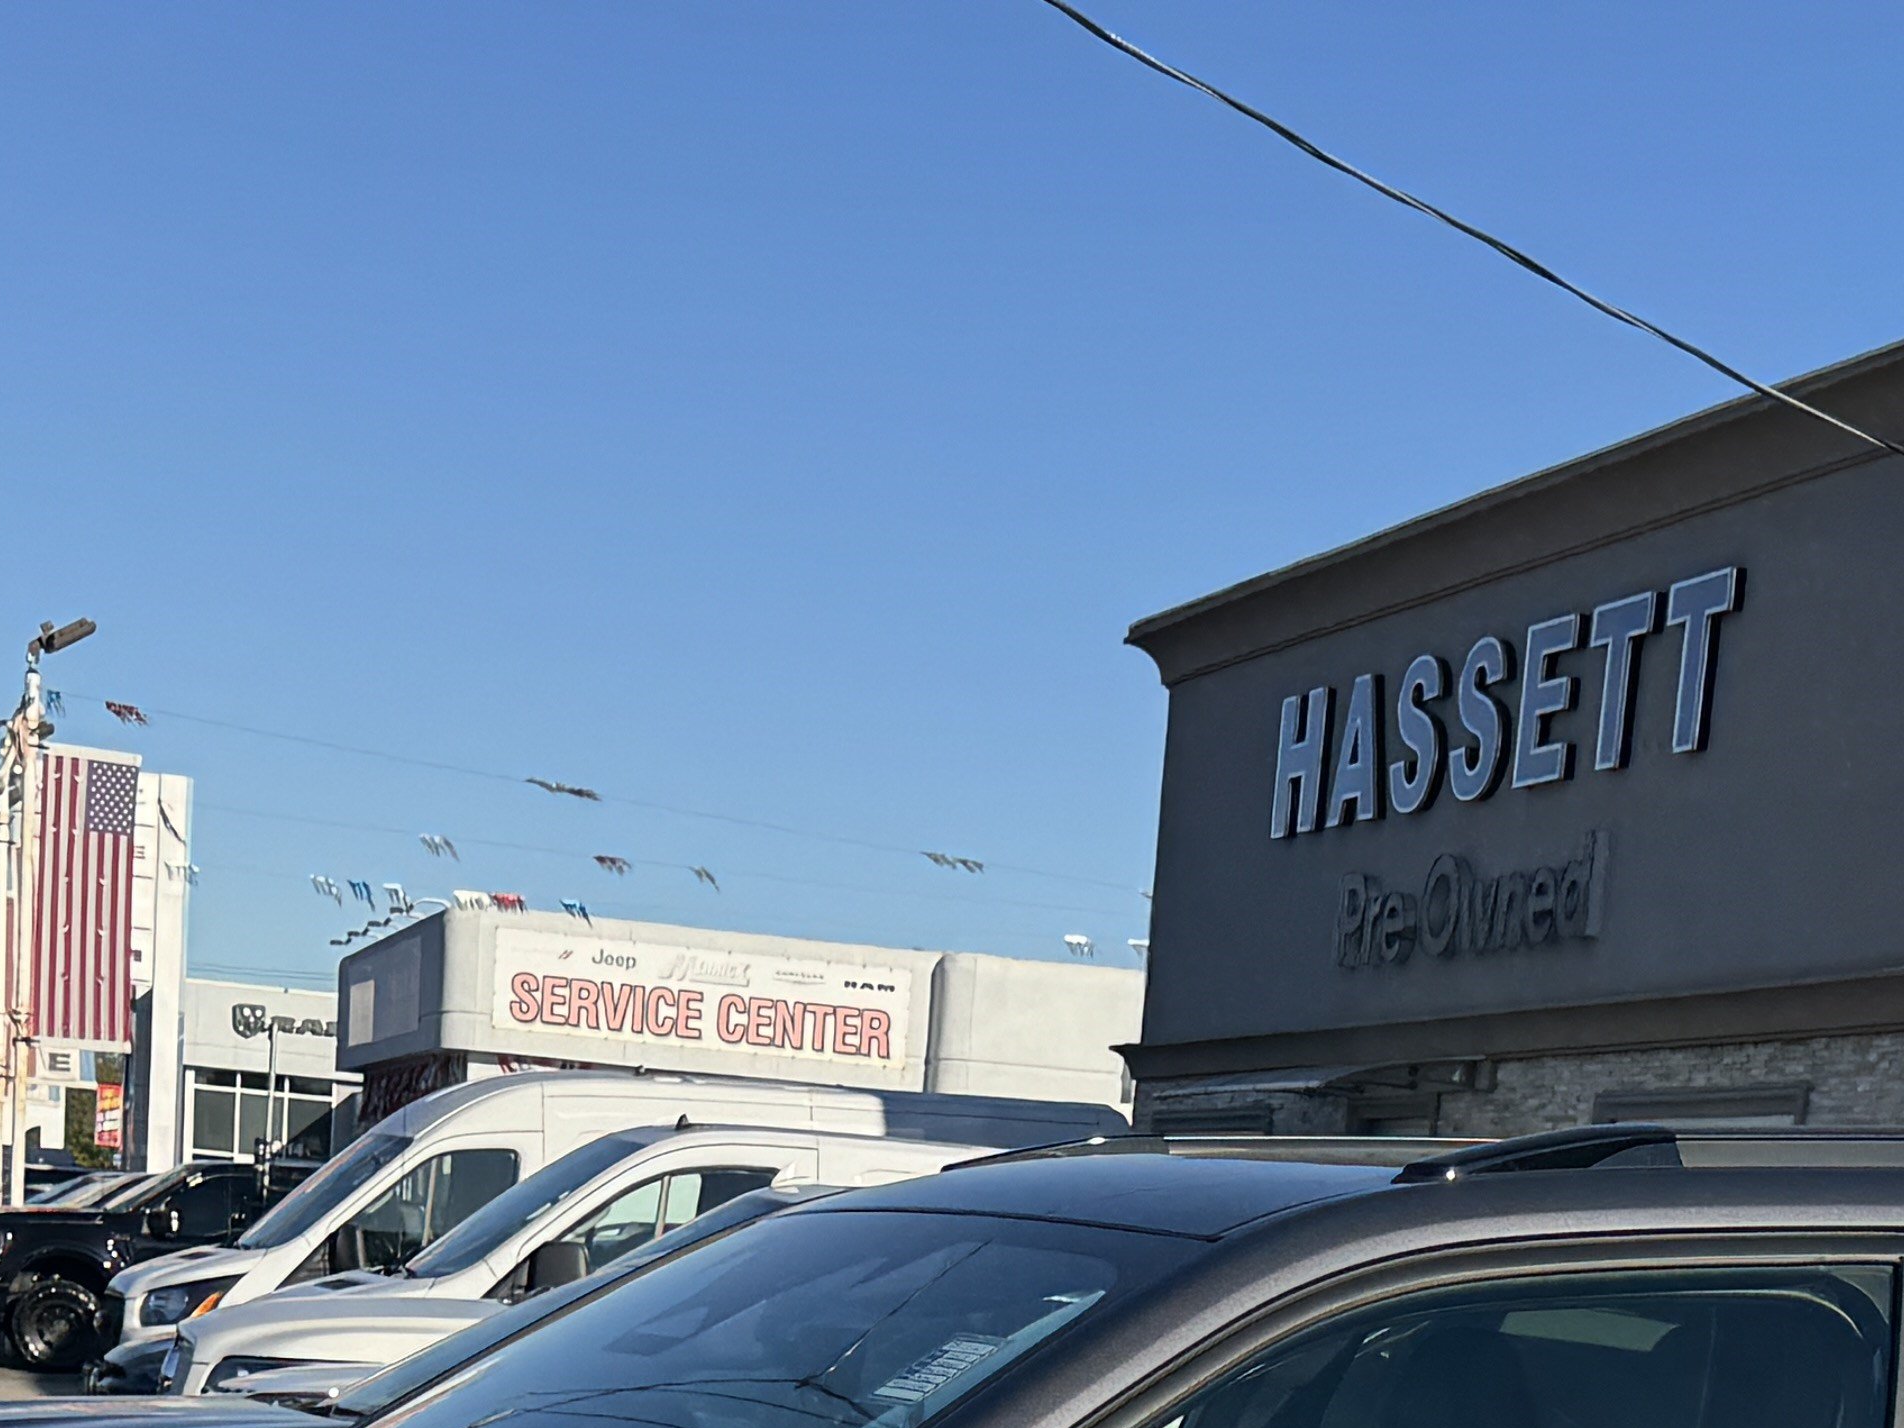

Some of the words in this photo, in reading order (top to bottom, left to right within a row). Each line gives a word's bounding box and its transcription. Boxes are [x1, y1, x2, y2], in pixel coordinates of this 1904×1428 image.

[1270, 566, 1746, 839] HASSETT
[592, 949, 637, 970] Jeep
[509, 972, 704, 1039] SERVICE
[717, 994, 891, 1060] CENTER
